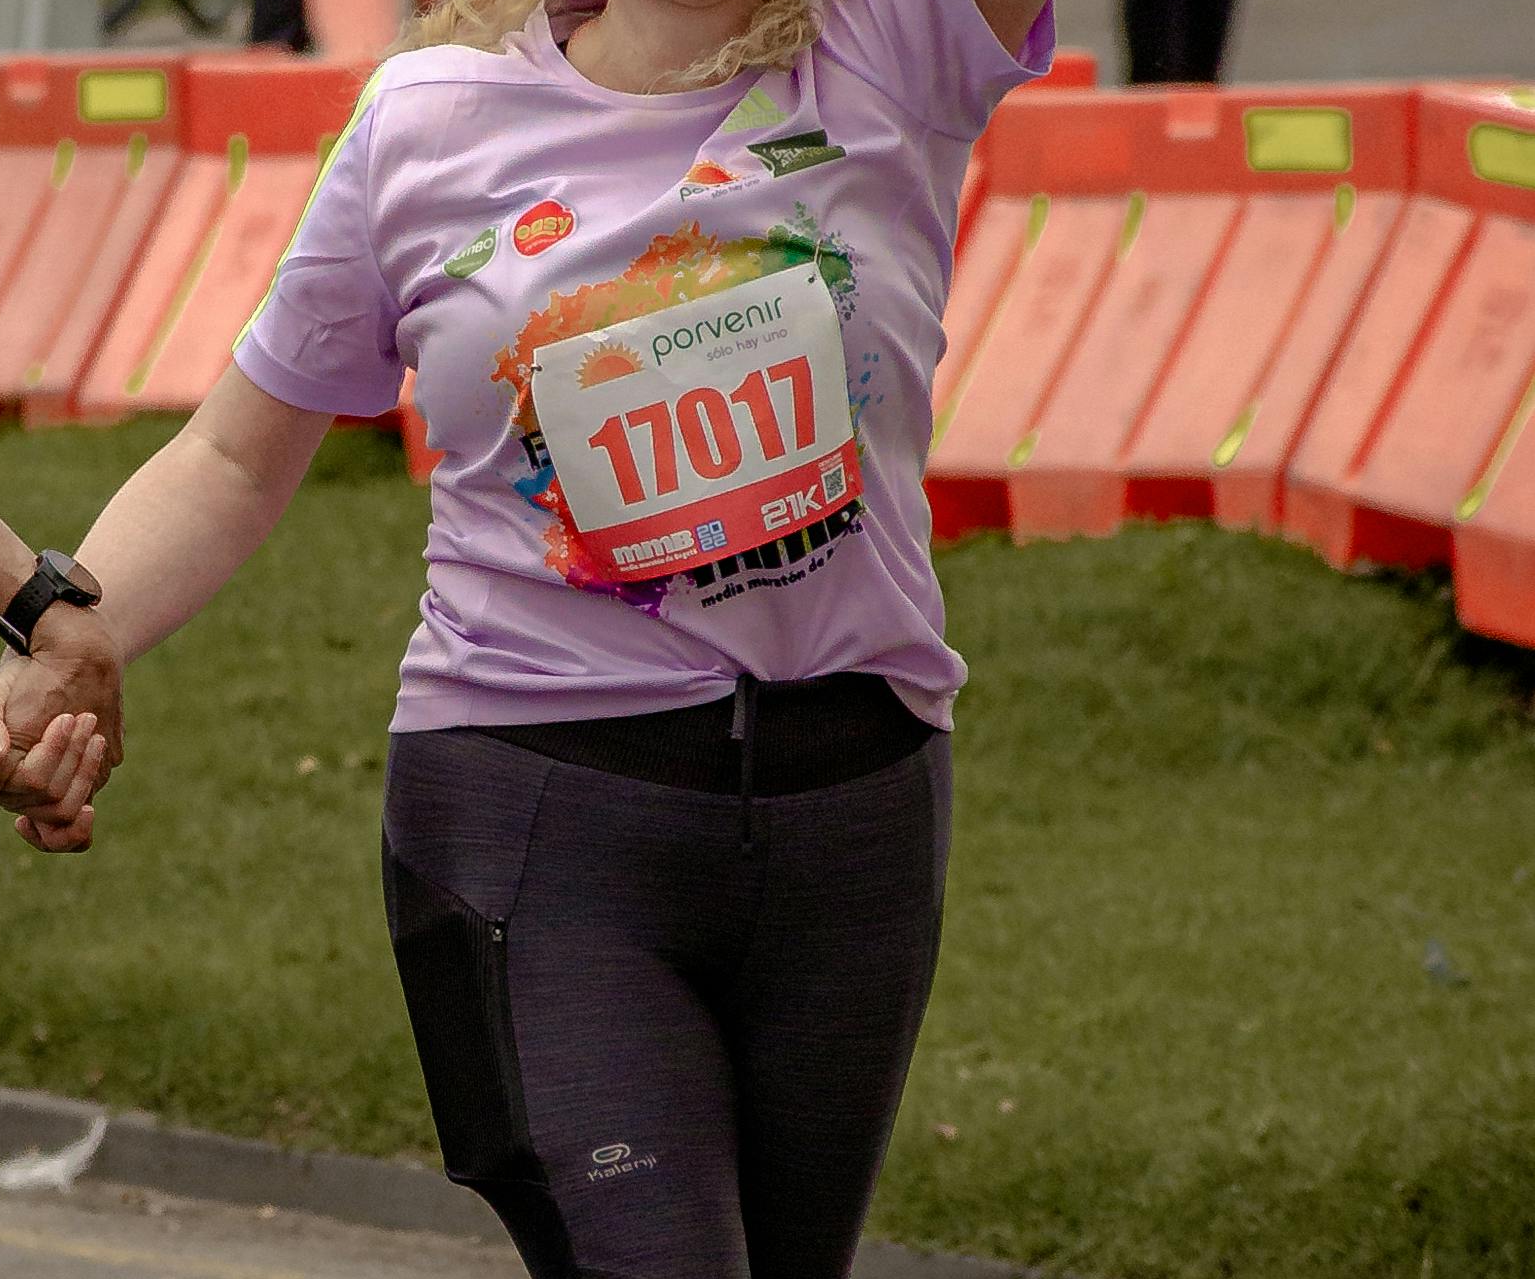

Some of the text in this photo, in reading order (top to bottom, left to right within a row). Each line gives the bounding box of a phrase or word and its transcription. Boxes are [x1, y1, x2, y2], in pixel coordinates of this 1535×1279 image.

[515, 216, 571, 240] easy
[652, 296, 782, 366] porvenir
[707, 328, 788, 362] sólo hay uno
[587, 355, 817, 506] 17017
[760, 484, 823, 532] 21K
[700, 557, 825, 609] media maratón de
[586, 1153, 658, 1182] Kalenji
